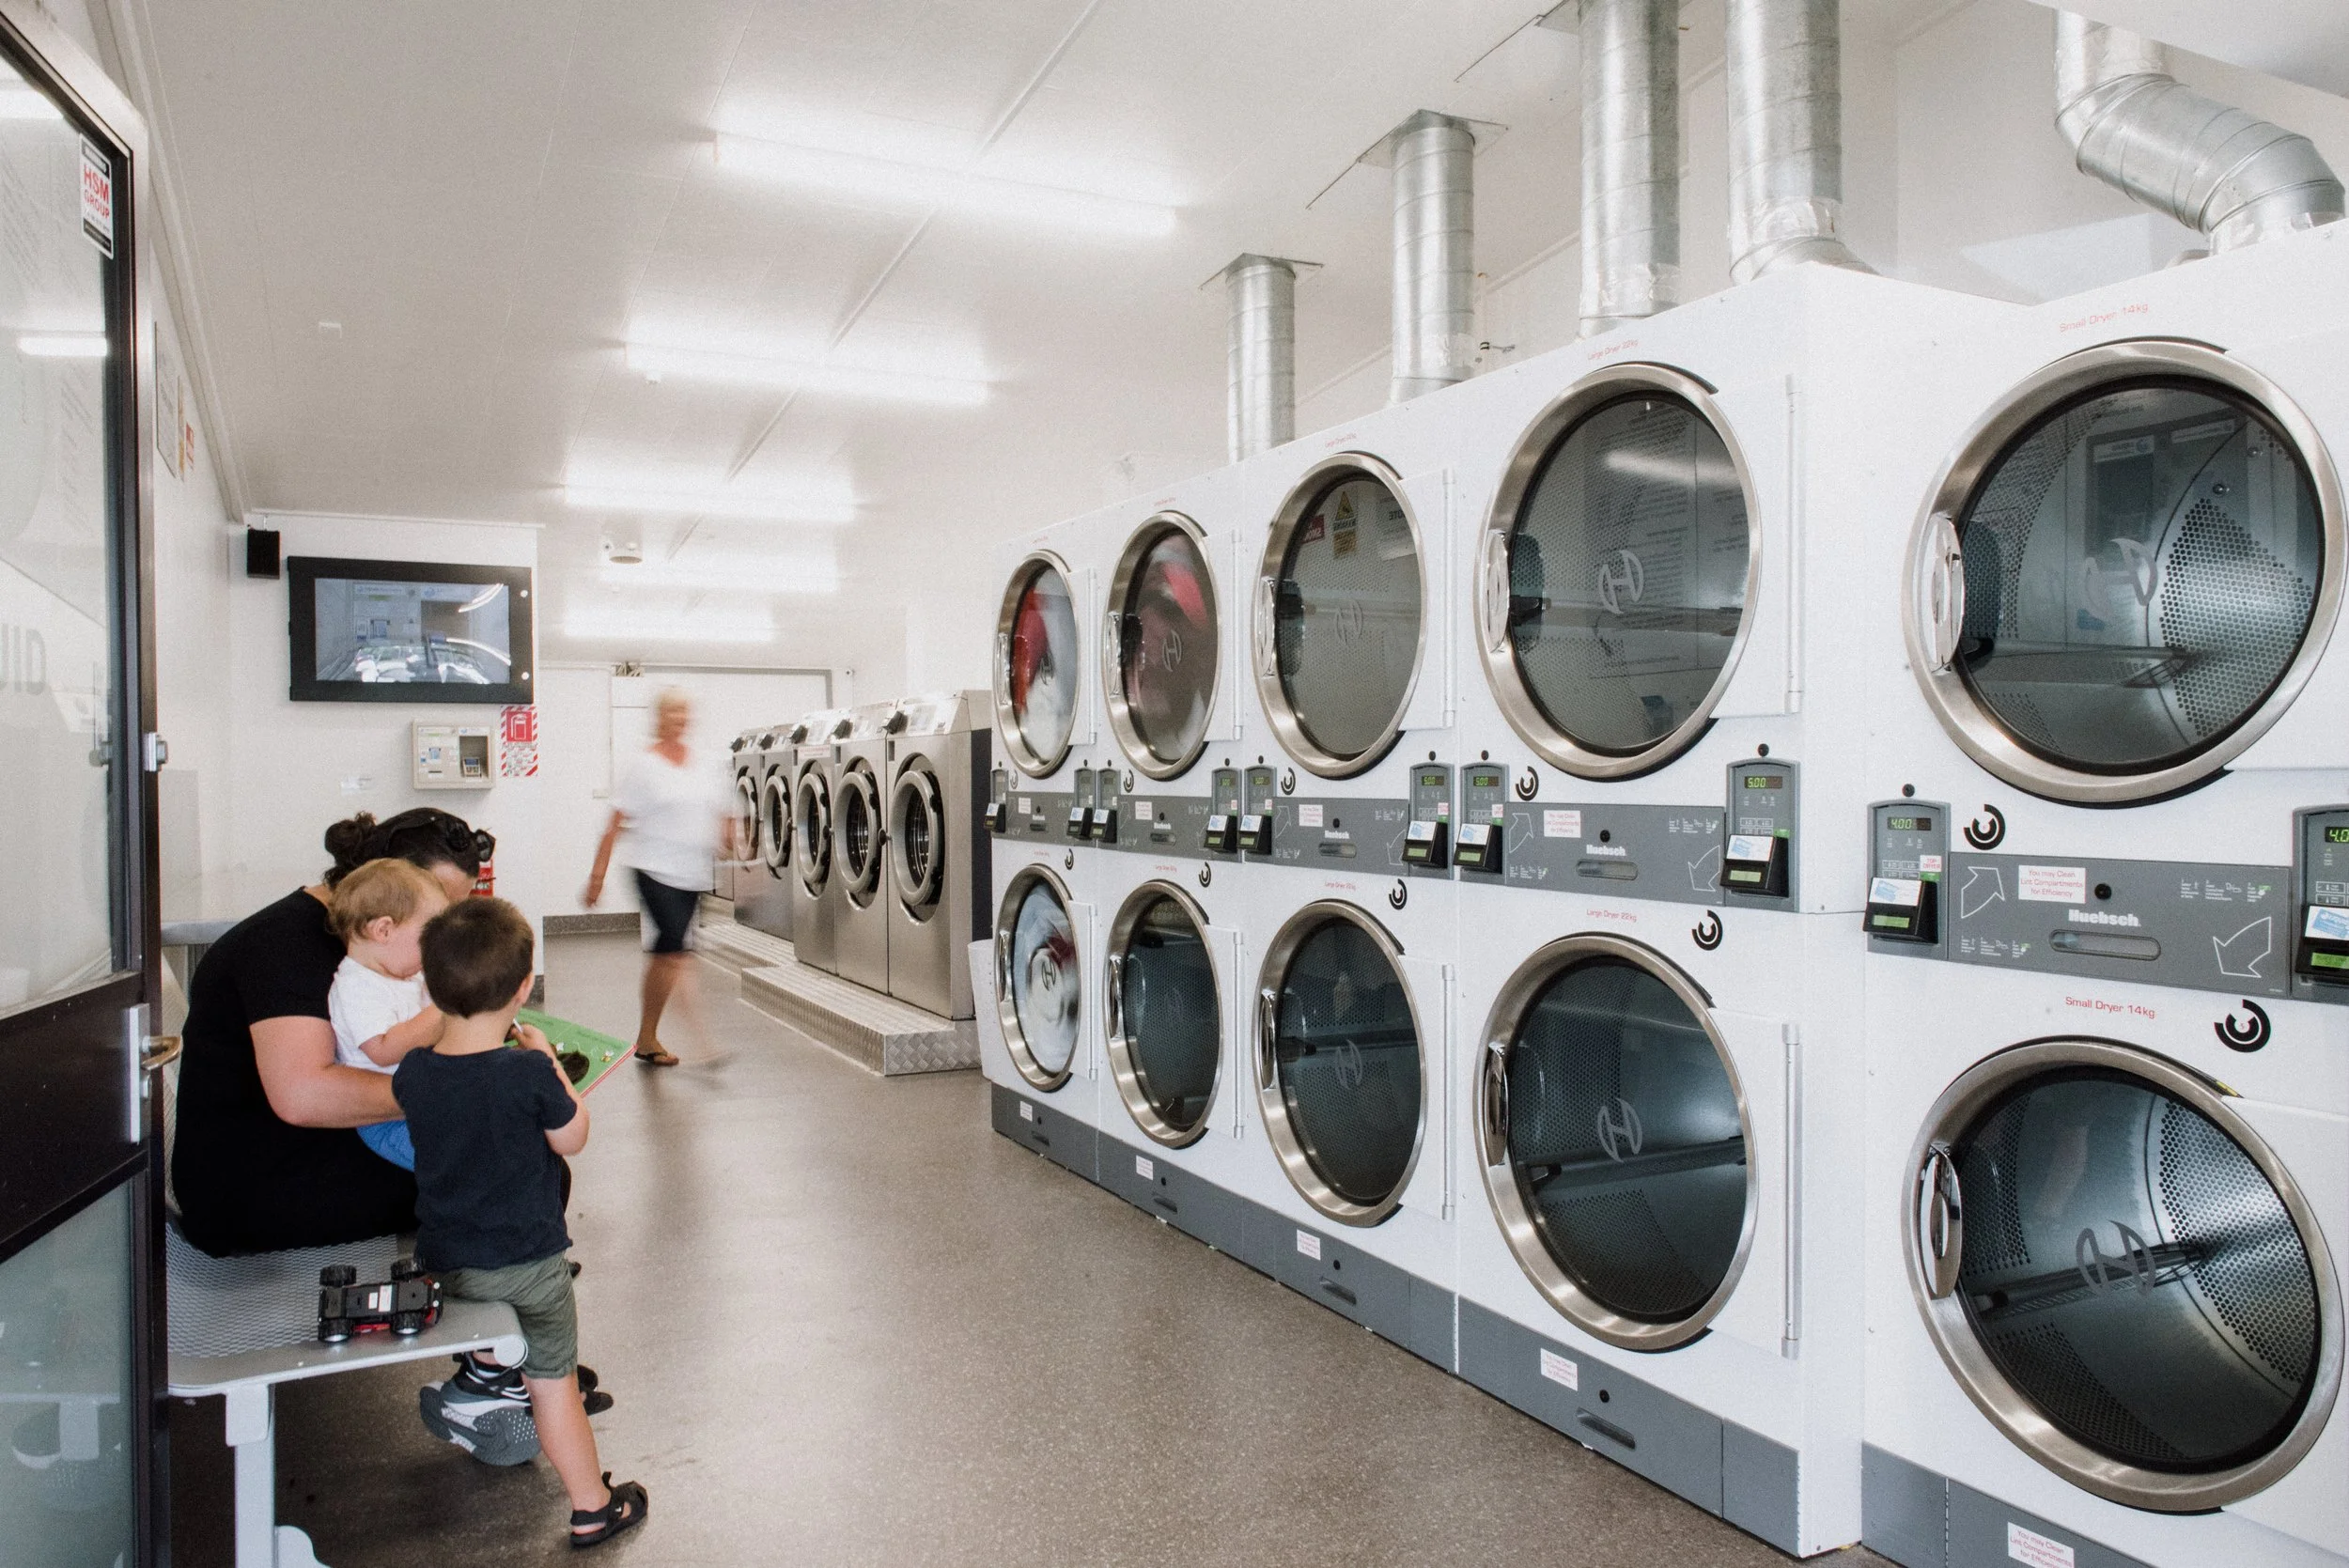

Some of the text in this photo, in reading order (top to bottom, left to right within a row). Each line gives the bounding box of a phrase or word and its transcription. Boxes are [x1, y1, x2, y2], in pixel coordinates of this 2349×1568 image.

[85, 163, 109, 205] HSM
[85, 190, 110, 219] GROUP
[2060, 303, 2149, 333] Small Dryer 14kg
[2034, 878, 2084, 888] Compartments
[2042, 888, 2073, 898] Efficiency
[2068, 908, 2140, 927] Huebsch
[2065, 996, 2155, 1019] Small Dryer 14kg
